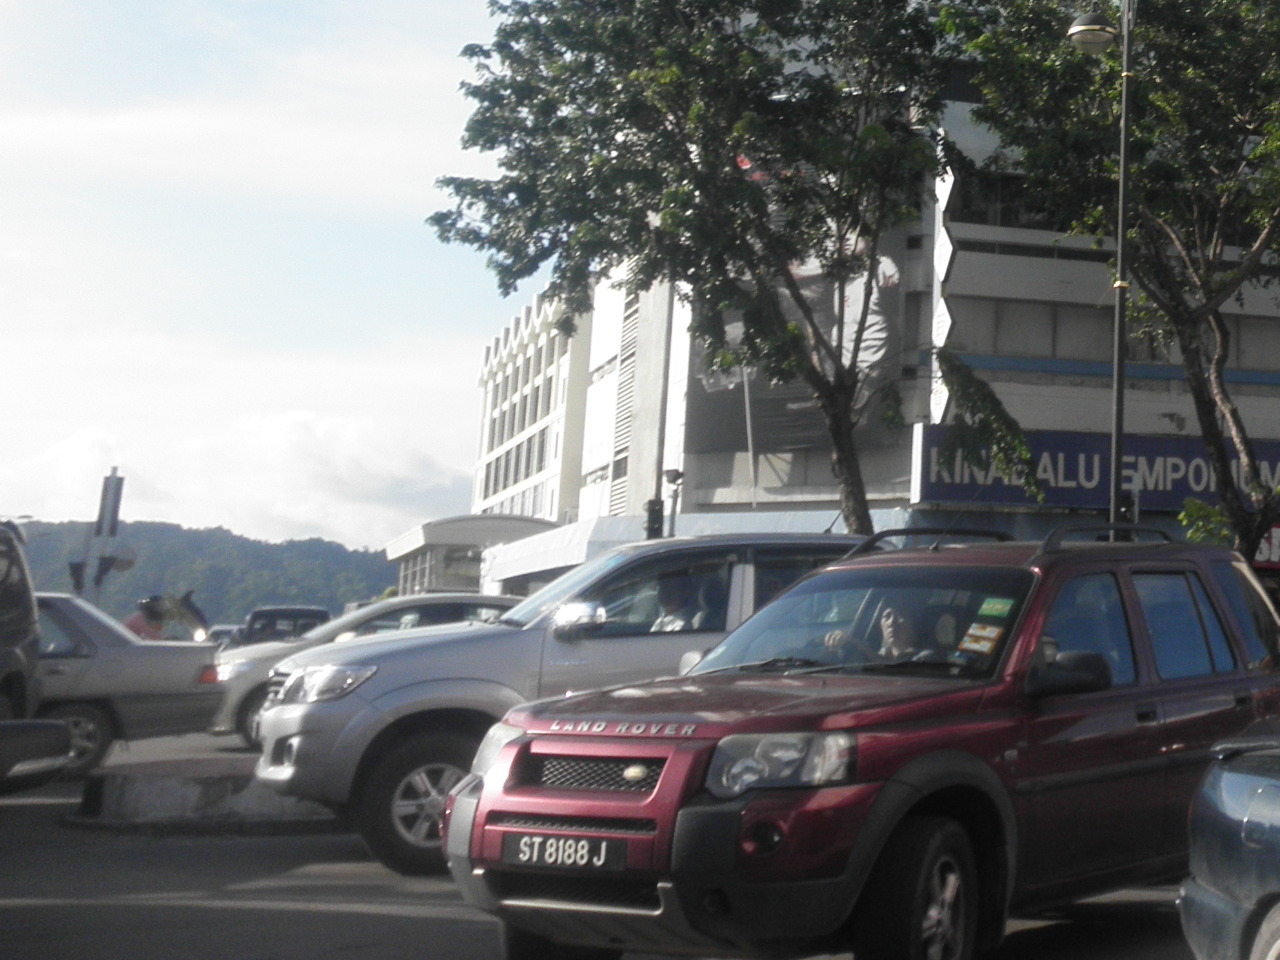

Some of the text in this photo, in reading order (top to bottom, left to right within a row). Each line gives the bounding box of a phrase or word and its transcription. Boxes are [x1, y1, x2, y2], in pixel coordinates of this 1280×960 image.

[550, 720, 697, 736] LAND ROVER
[518, 836, 607, 867] ST 8188 J
